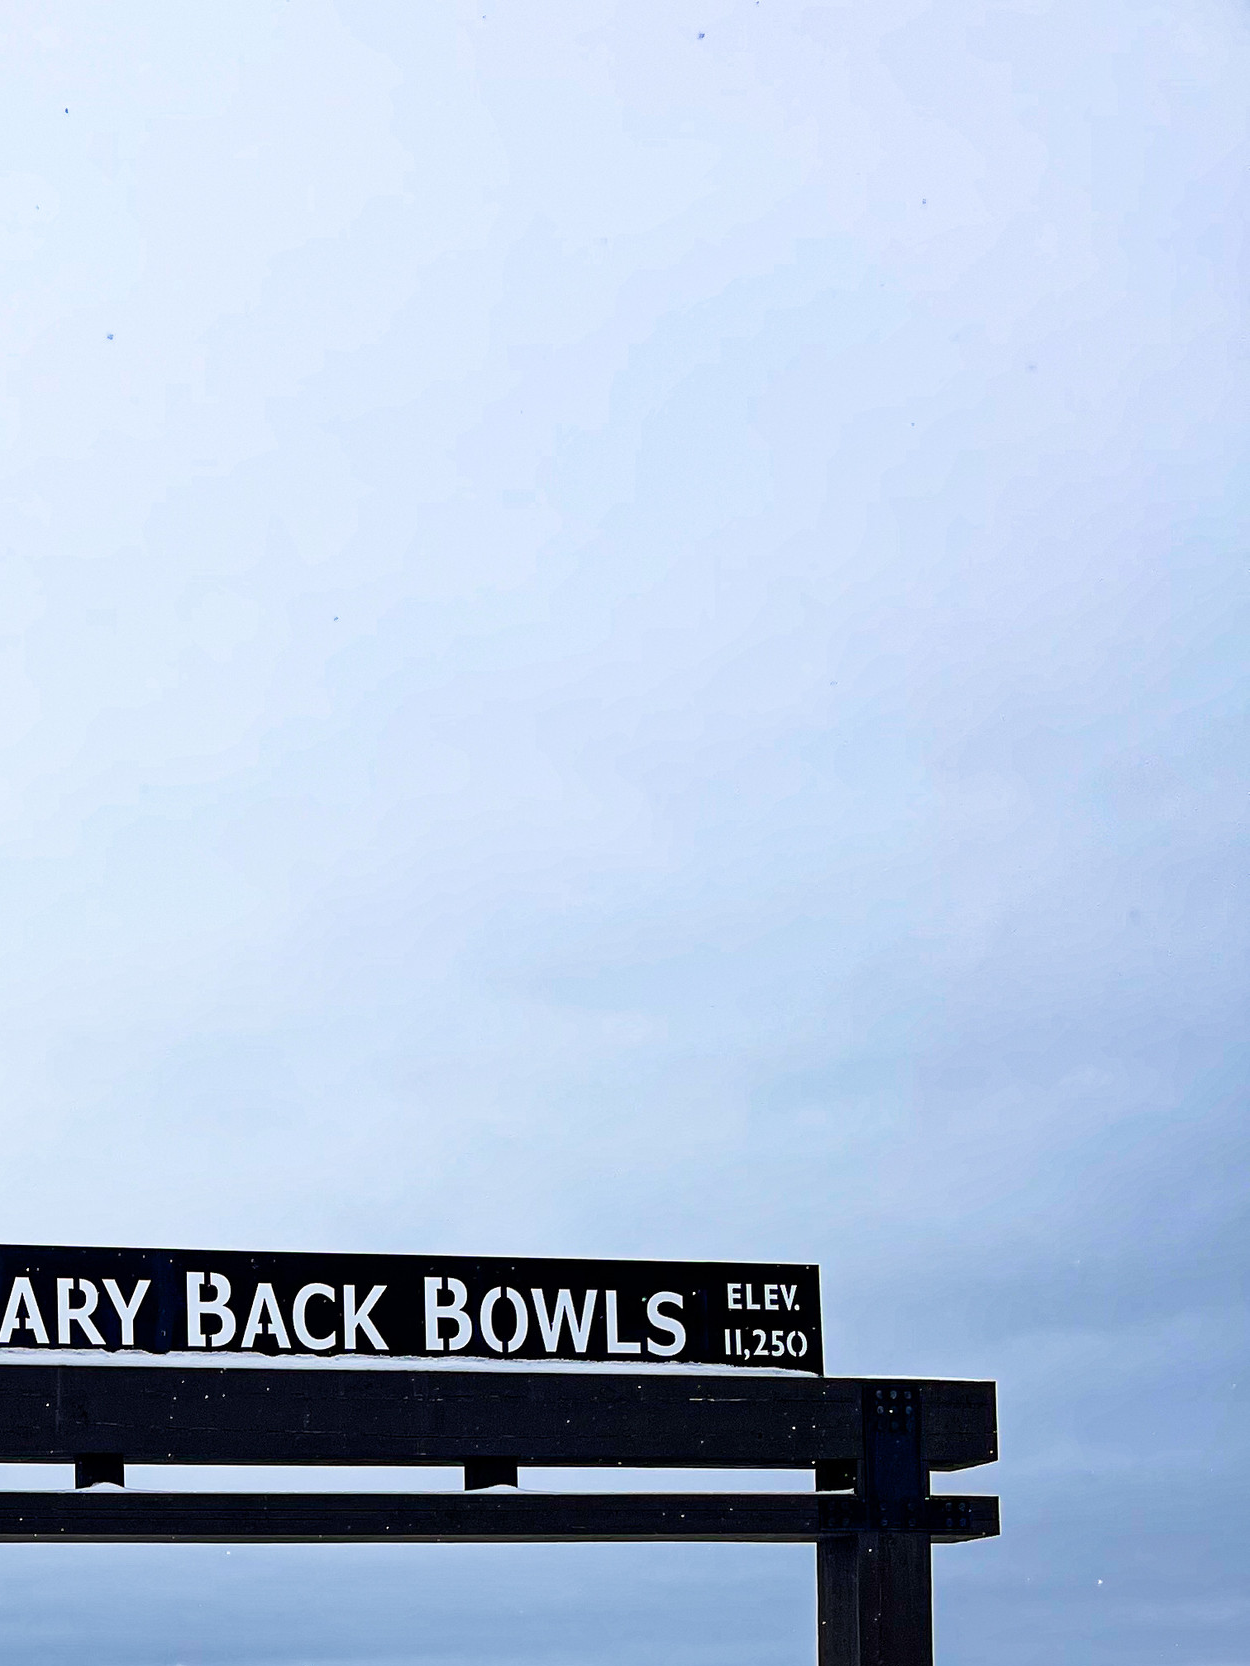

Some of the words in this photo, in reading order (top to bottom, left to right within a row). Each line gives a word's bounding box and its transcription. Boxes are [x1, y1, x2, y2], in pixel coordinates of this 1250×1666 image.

[726, 1282, 801, 1312] ELEV.
[186, 1271, 390, 1351] BACK
[423, 1276, 687, 1357] BOWLS
[723, 1328, 808, 1361] 11,250
